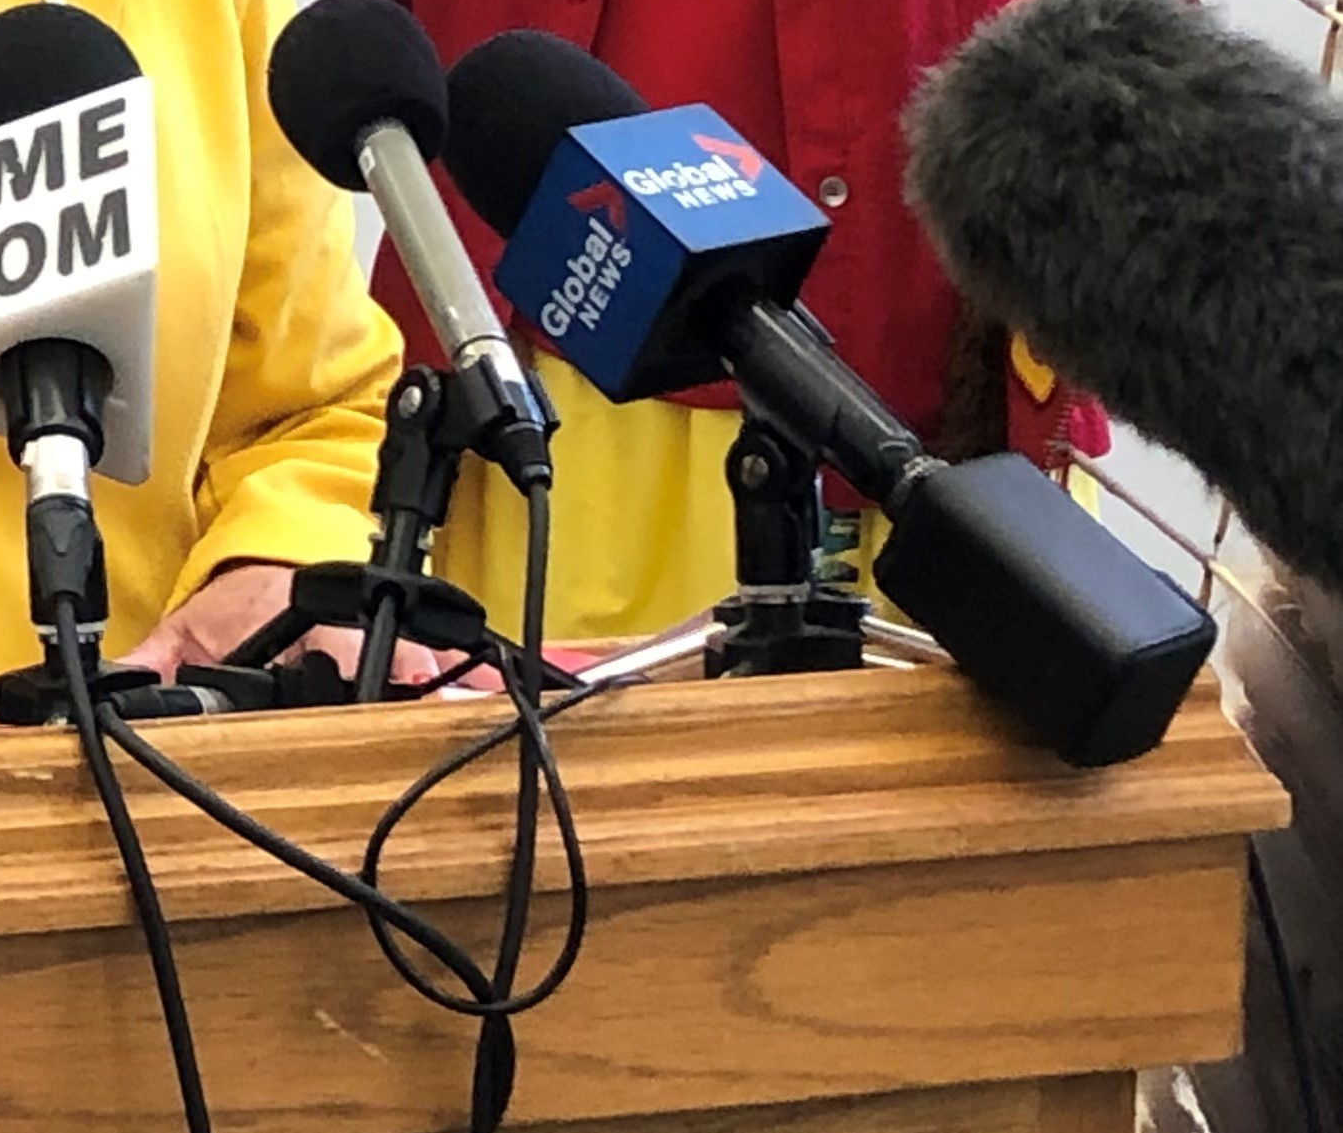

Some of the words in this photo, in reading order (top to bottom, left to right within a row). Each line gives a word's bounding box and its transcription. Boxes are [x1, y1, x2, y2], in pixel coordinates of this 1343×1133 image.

[622, 153, 740, 196] Global
[672, 178, 758, 209] NEWS
[540, 215, 614, 338] Global
[577, 241, 632, 331] NEWS
